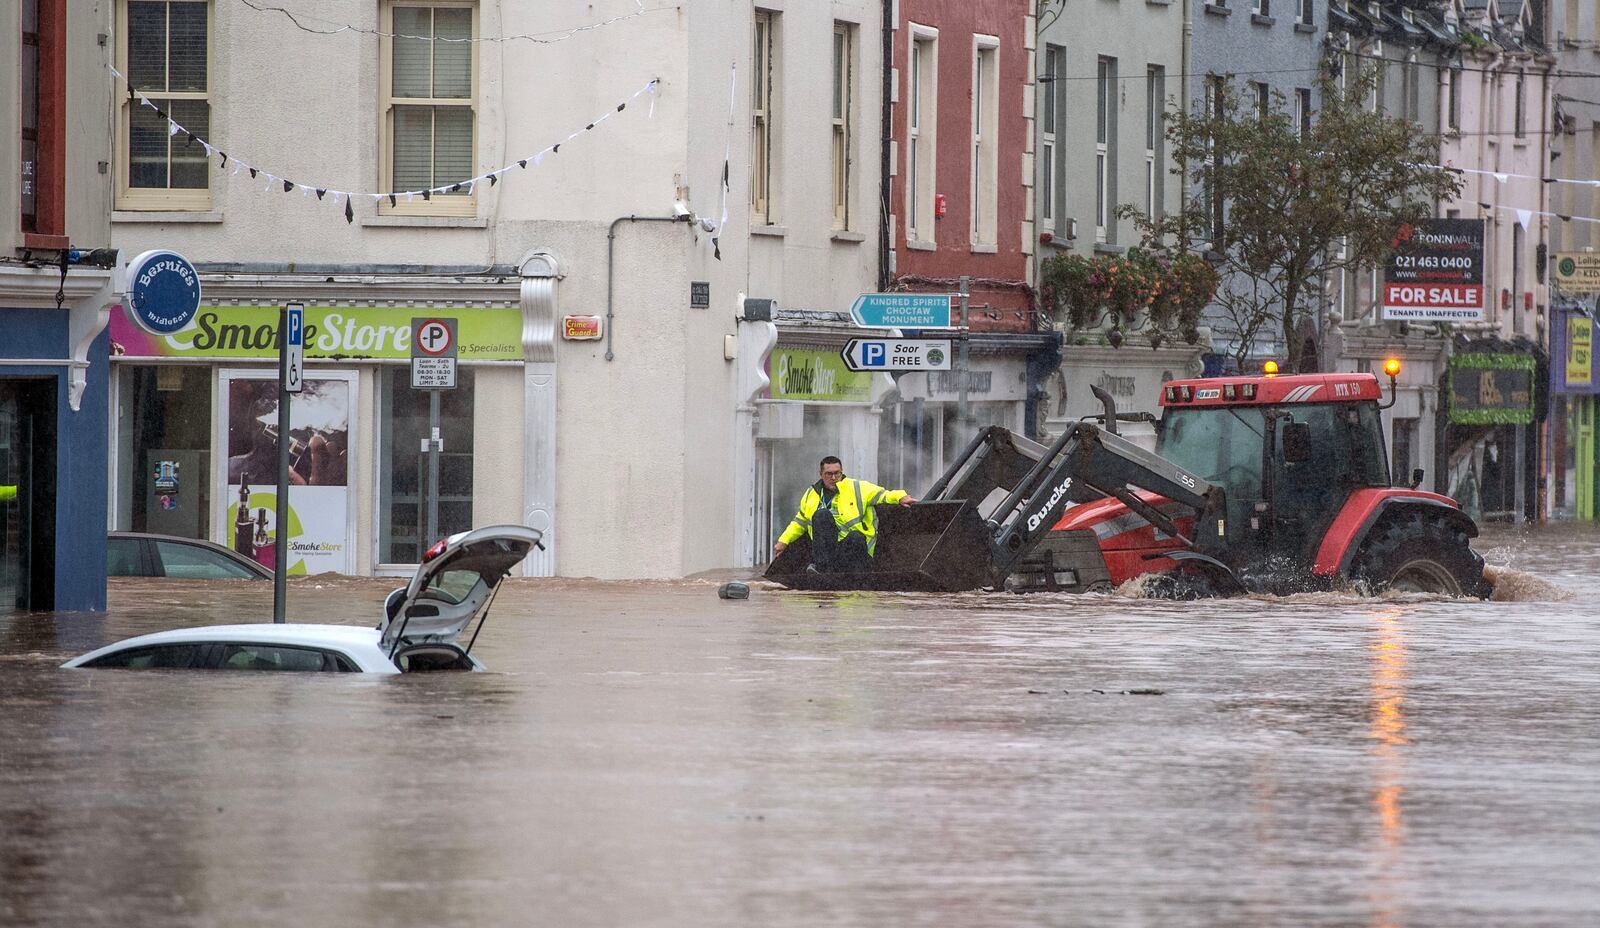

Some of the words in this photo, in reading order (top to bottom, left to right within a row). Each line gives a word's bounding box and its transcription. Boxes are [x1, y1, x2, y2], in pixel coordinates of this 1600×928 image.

[1396, 256, 1415, 267] 021
[1418, 256, 1438, 268] 463
[1441, 256, 1472, 268] 0400
[139, 260, 194, 287] Bernie's
[1390, 287, 1425, 303] FOR
[1429, 288, 1477, 304] SALE
[912, 298, 947, 306] SPIRITS
[566, 319, 587, 328] Crime
[882, 316, 935, 324] MONUMENT
[291, 313, 299, 341] P
[569, 327, 592, 336] Guard
[429, 326, 443, 348] P
[468, 343, 516, 354] Specialists
[867, 344, 883, 365] P
[894, 344, 920, 353] Saor
[892, 356, 921, 365] FREE
[1334, 383, 1350, 397] MTX
[1027, 477, 1073, 531] Quicke
